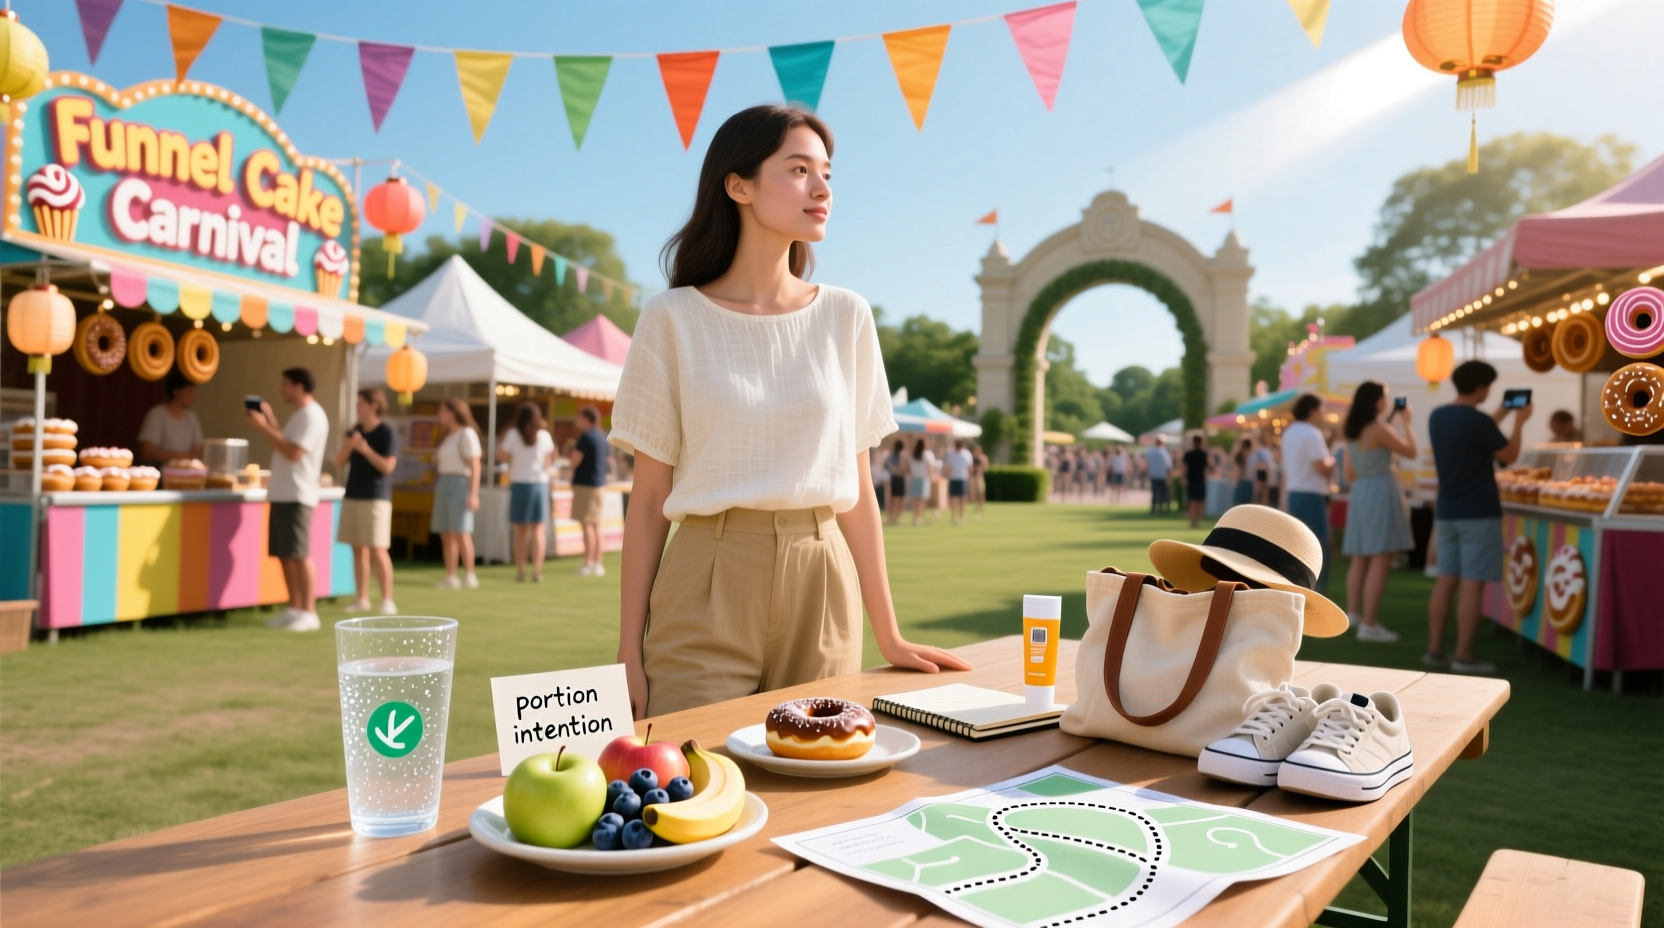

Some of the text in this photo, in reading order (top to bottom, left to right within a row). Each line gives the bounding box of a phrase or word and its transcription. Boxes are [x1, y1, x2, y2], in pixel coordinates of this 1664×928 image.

[53, 96, 345, 239] Funnel Cake
[111, 177, 299, 278] Carnival
[513, 714, 613, 744] intention
[516, 686, 598, 720] portion
